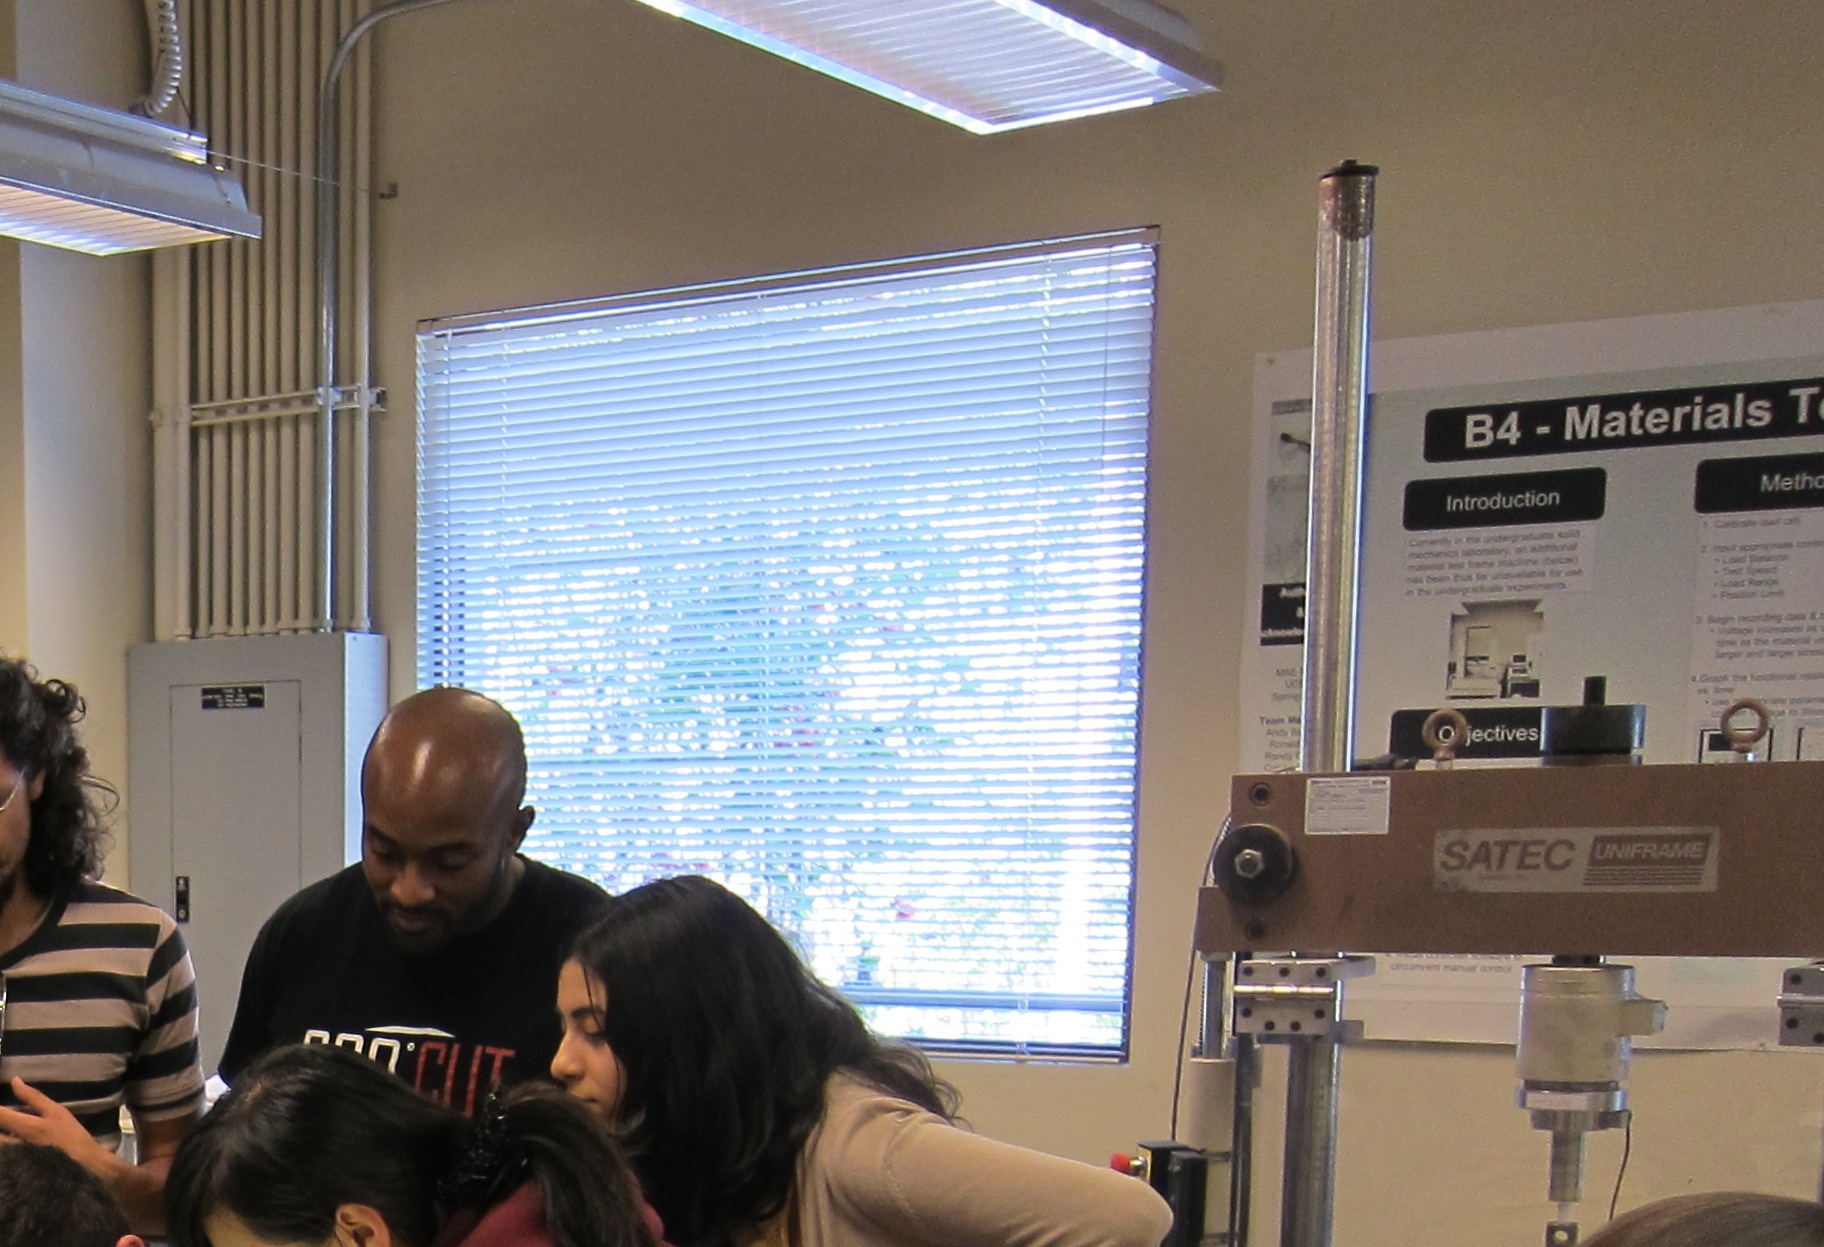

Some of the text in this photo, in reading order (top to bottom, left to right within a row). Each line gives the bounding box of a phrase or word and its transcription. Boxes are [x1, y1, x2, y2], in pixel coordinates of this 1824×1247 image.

[1465, 411, 1522, 448] B4
[1564, 392, 1774, 441] Materials
[1788, 386, 1824, 424] T
[1446, 489, 1561, 512] Introduction
[1483, 533, 1555, 544] undergraduate
[1439, 725, 1538, 747] Ojectives
[1439, 839, 1706, 872] SATEC UNIFRAME
